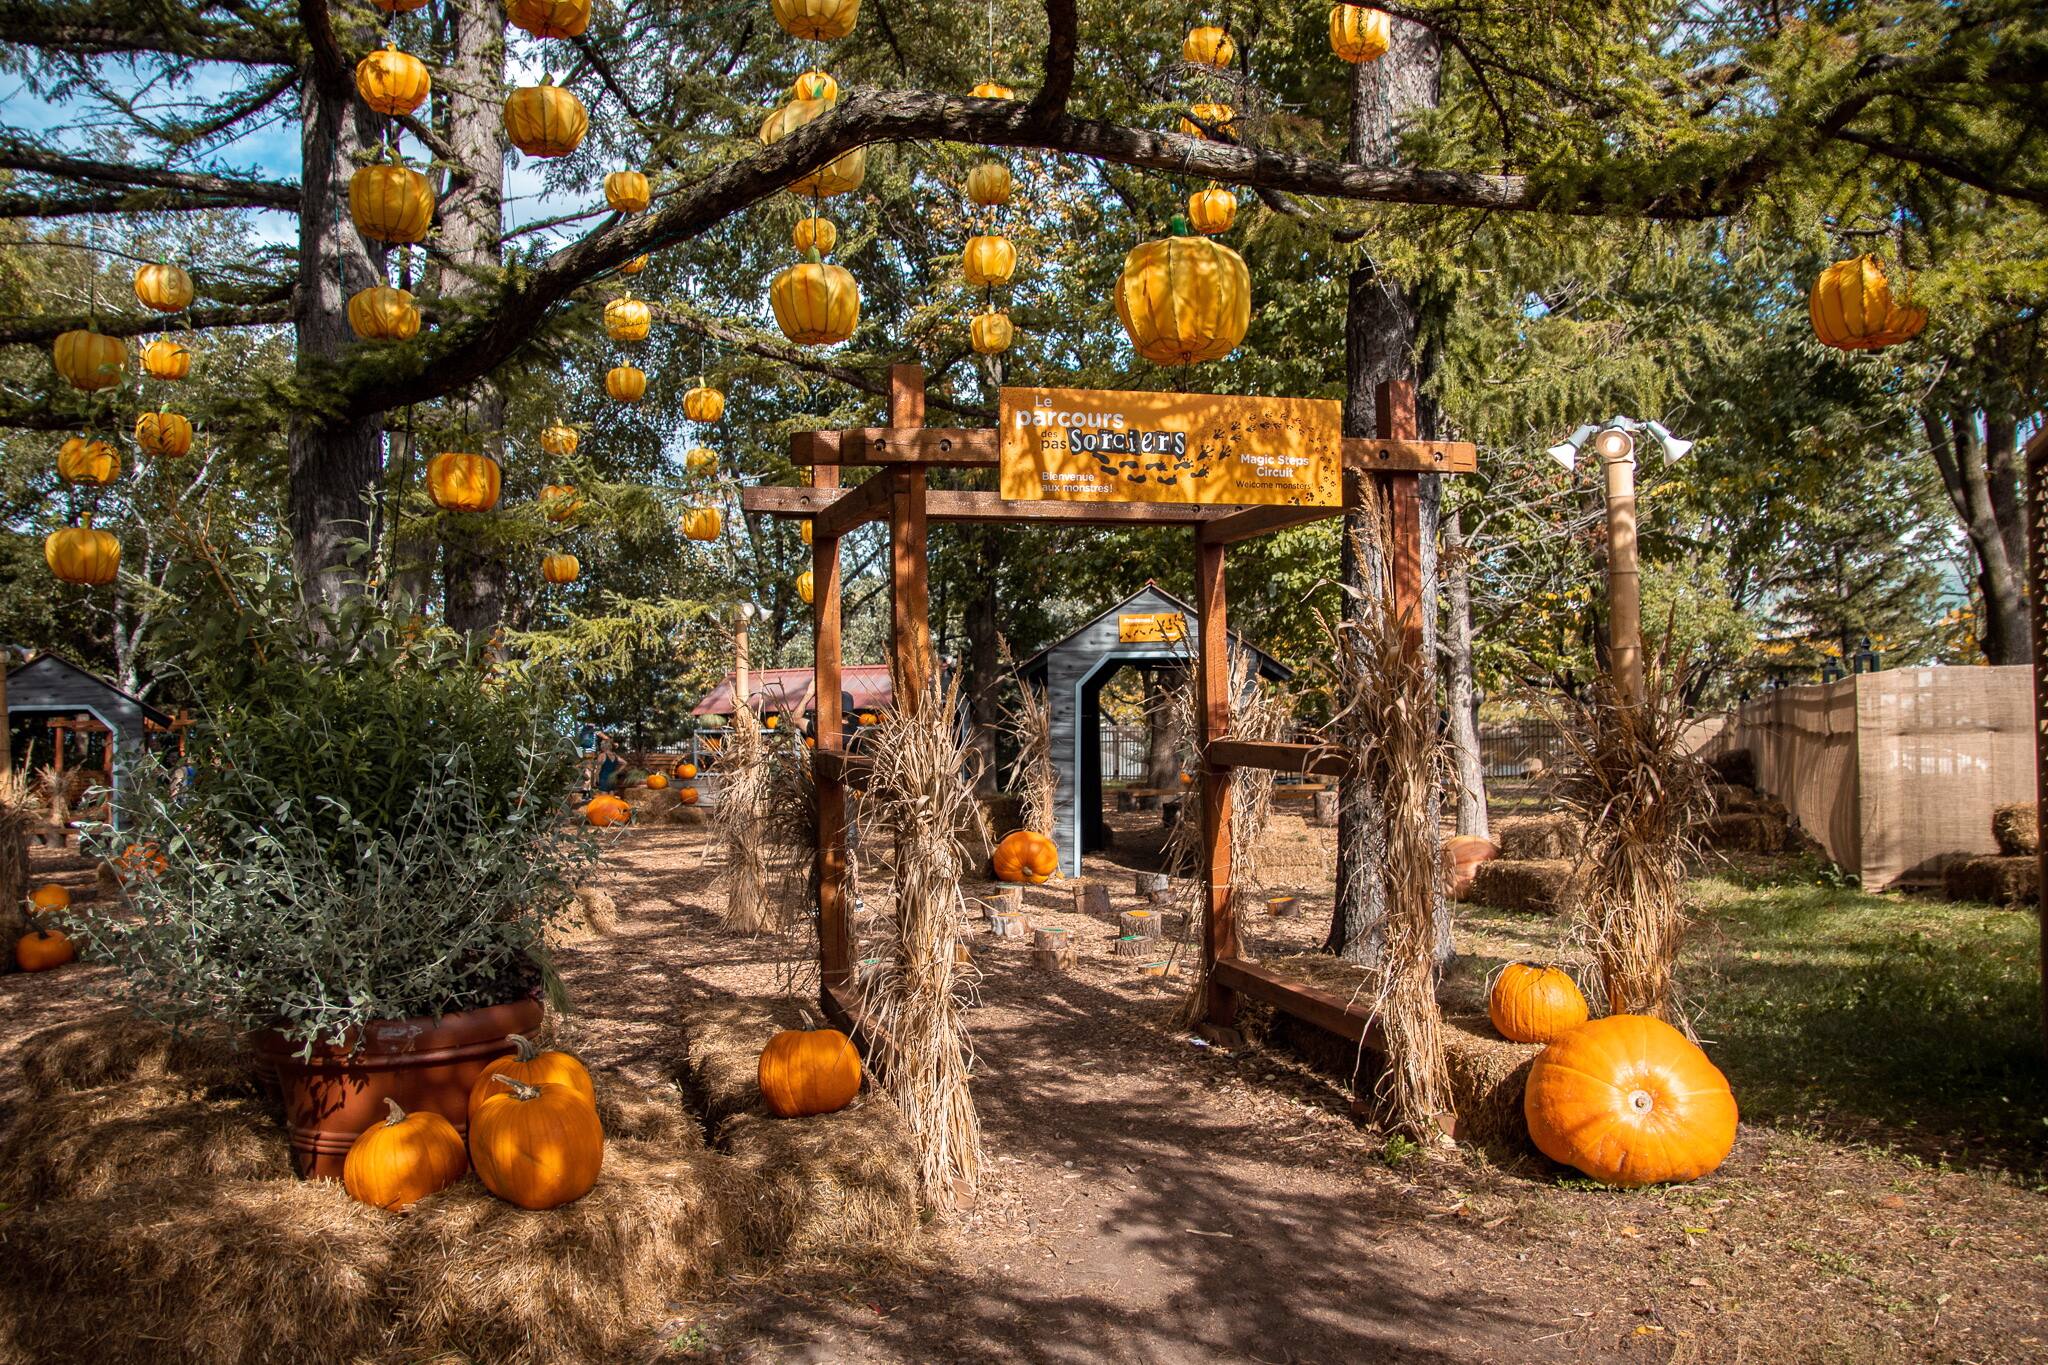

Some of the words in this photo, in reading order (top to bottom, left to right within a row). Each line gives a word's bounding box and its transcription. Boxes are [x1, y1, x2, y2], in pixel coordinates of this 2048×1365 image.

[1035, 395, 1052, 407] Le
[1015, 409, 1125, 429] parcours
[1041, 430, 1058, 438] des
[1041, 439, 1067, 450] pas
[1071, 429, 1185, 454] Sorciers
[1240, 454, 1274, 466] Magic
[1277, 455, 1309, 467] Steps
[1042, 472, 1095, 482] Bienvenue
[1256, 467, 1293, 477] Circuit
[1042, 485, 1060, 493] aux
[1063, 484, 1113, 493] monstres!
[1236, 480, 1273, 489] Welcome
